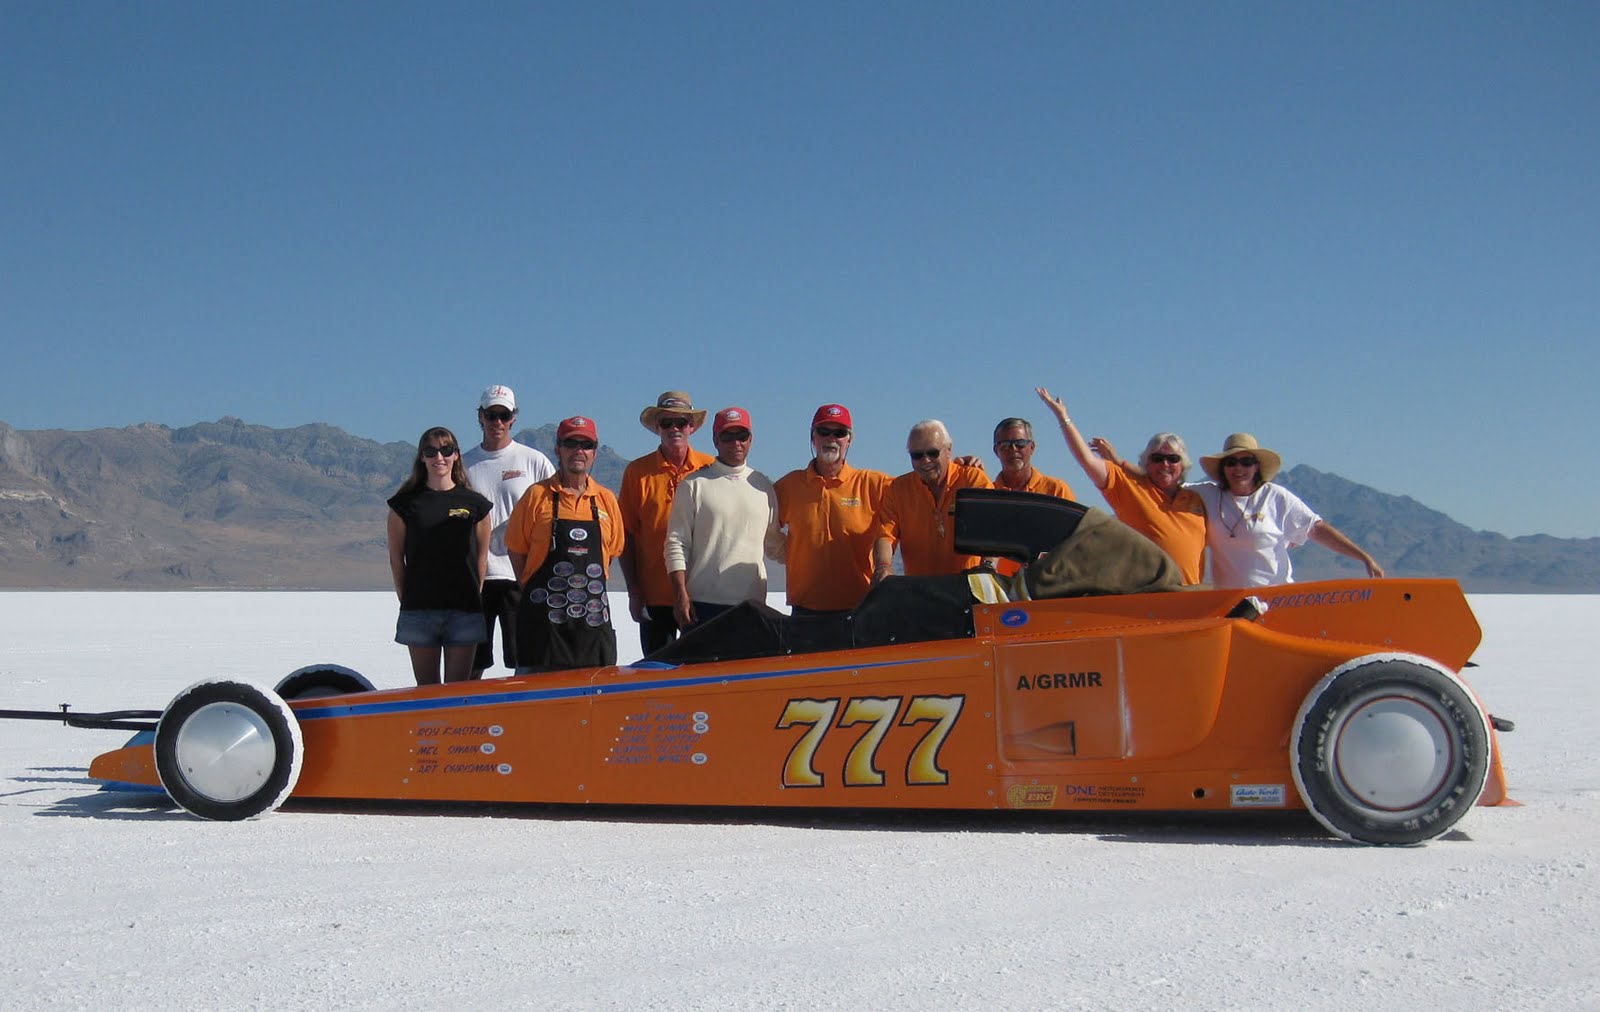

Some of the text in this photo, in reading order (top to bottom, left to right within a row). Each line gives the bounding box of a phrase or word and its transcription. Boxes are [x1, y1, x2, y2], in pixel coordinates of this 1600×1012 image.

[1016, 671, 1103, 690] A/GRMR
[775, 694, 966, 788] 777
[416, 746, 439, 756] MEL
[1066, 784, 1096, 796] DNE
